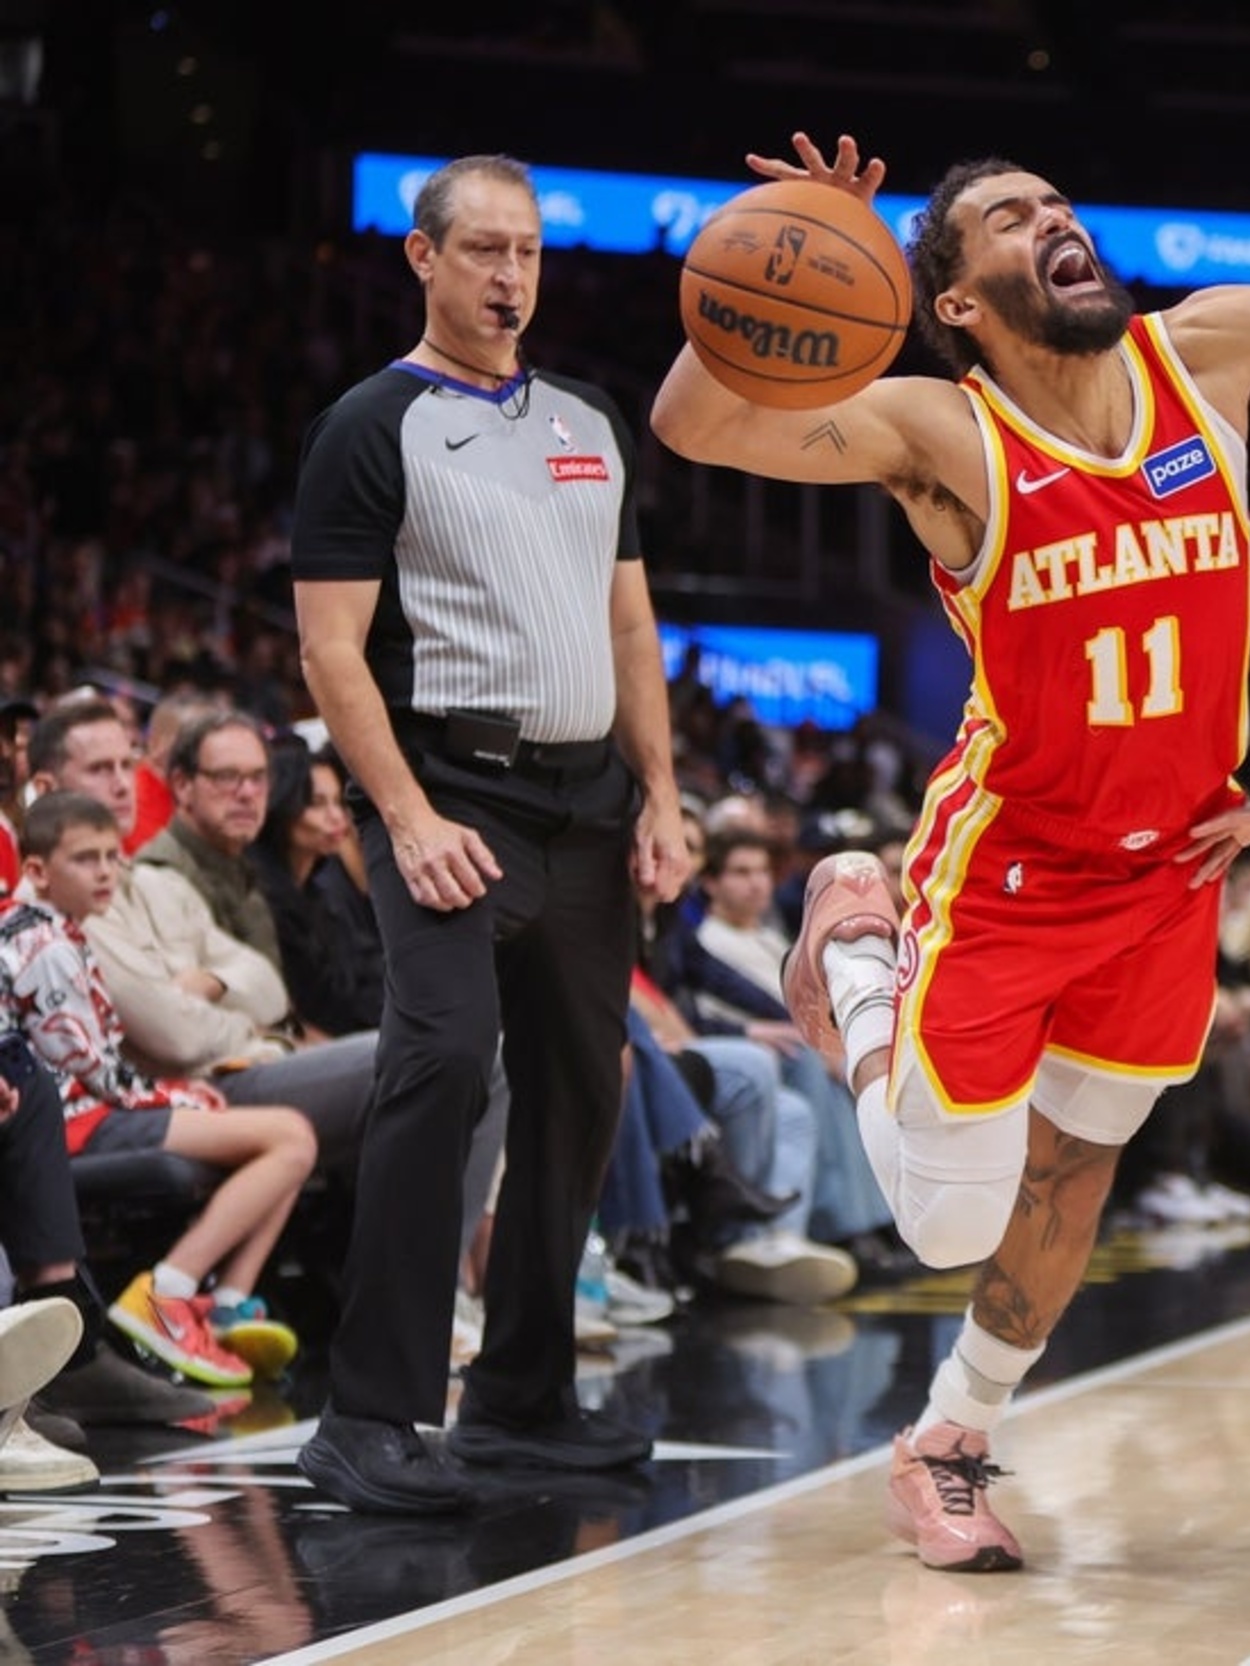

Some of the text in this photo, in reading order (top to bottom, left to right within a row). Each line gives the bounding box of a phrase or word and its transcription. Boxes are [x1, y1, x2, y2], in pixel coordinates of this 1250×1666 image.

[698, 288, 840, 367] Wilson
[1151, 449, 1205, 487] paze
[1007, 512, 1240, 611] ATLANTA
[1085, 615, 1184, 727] 11
